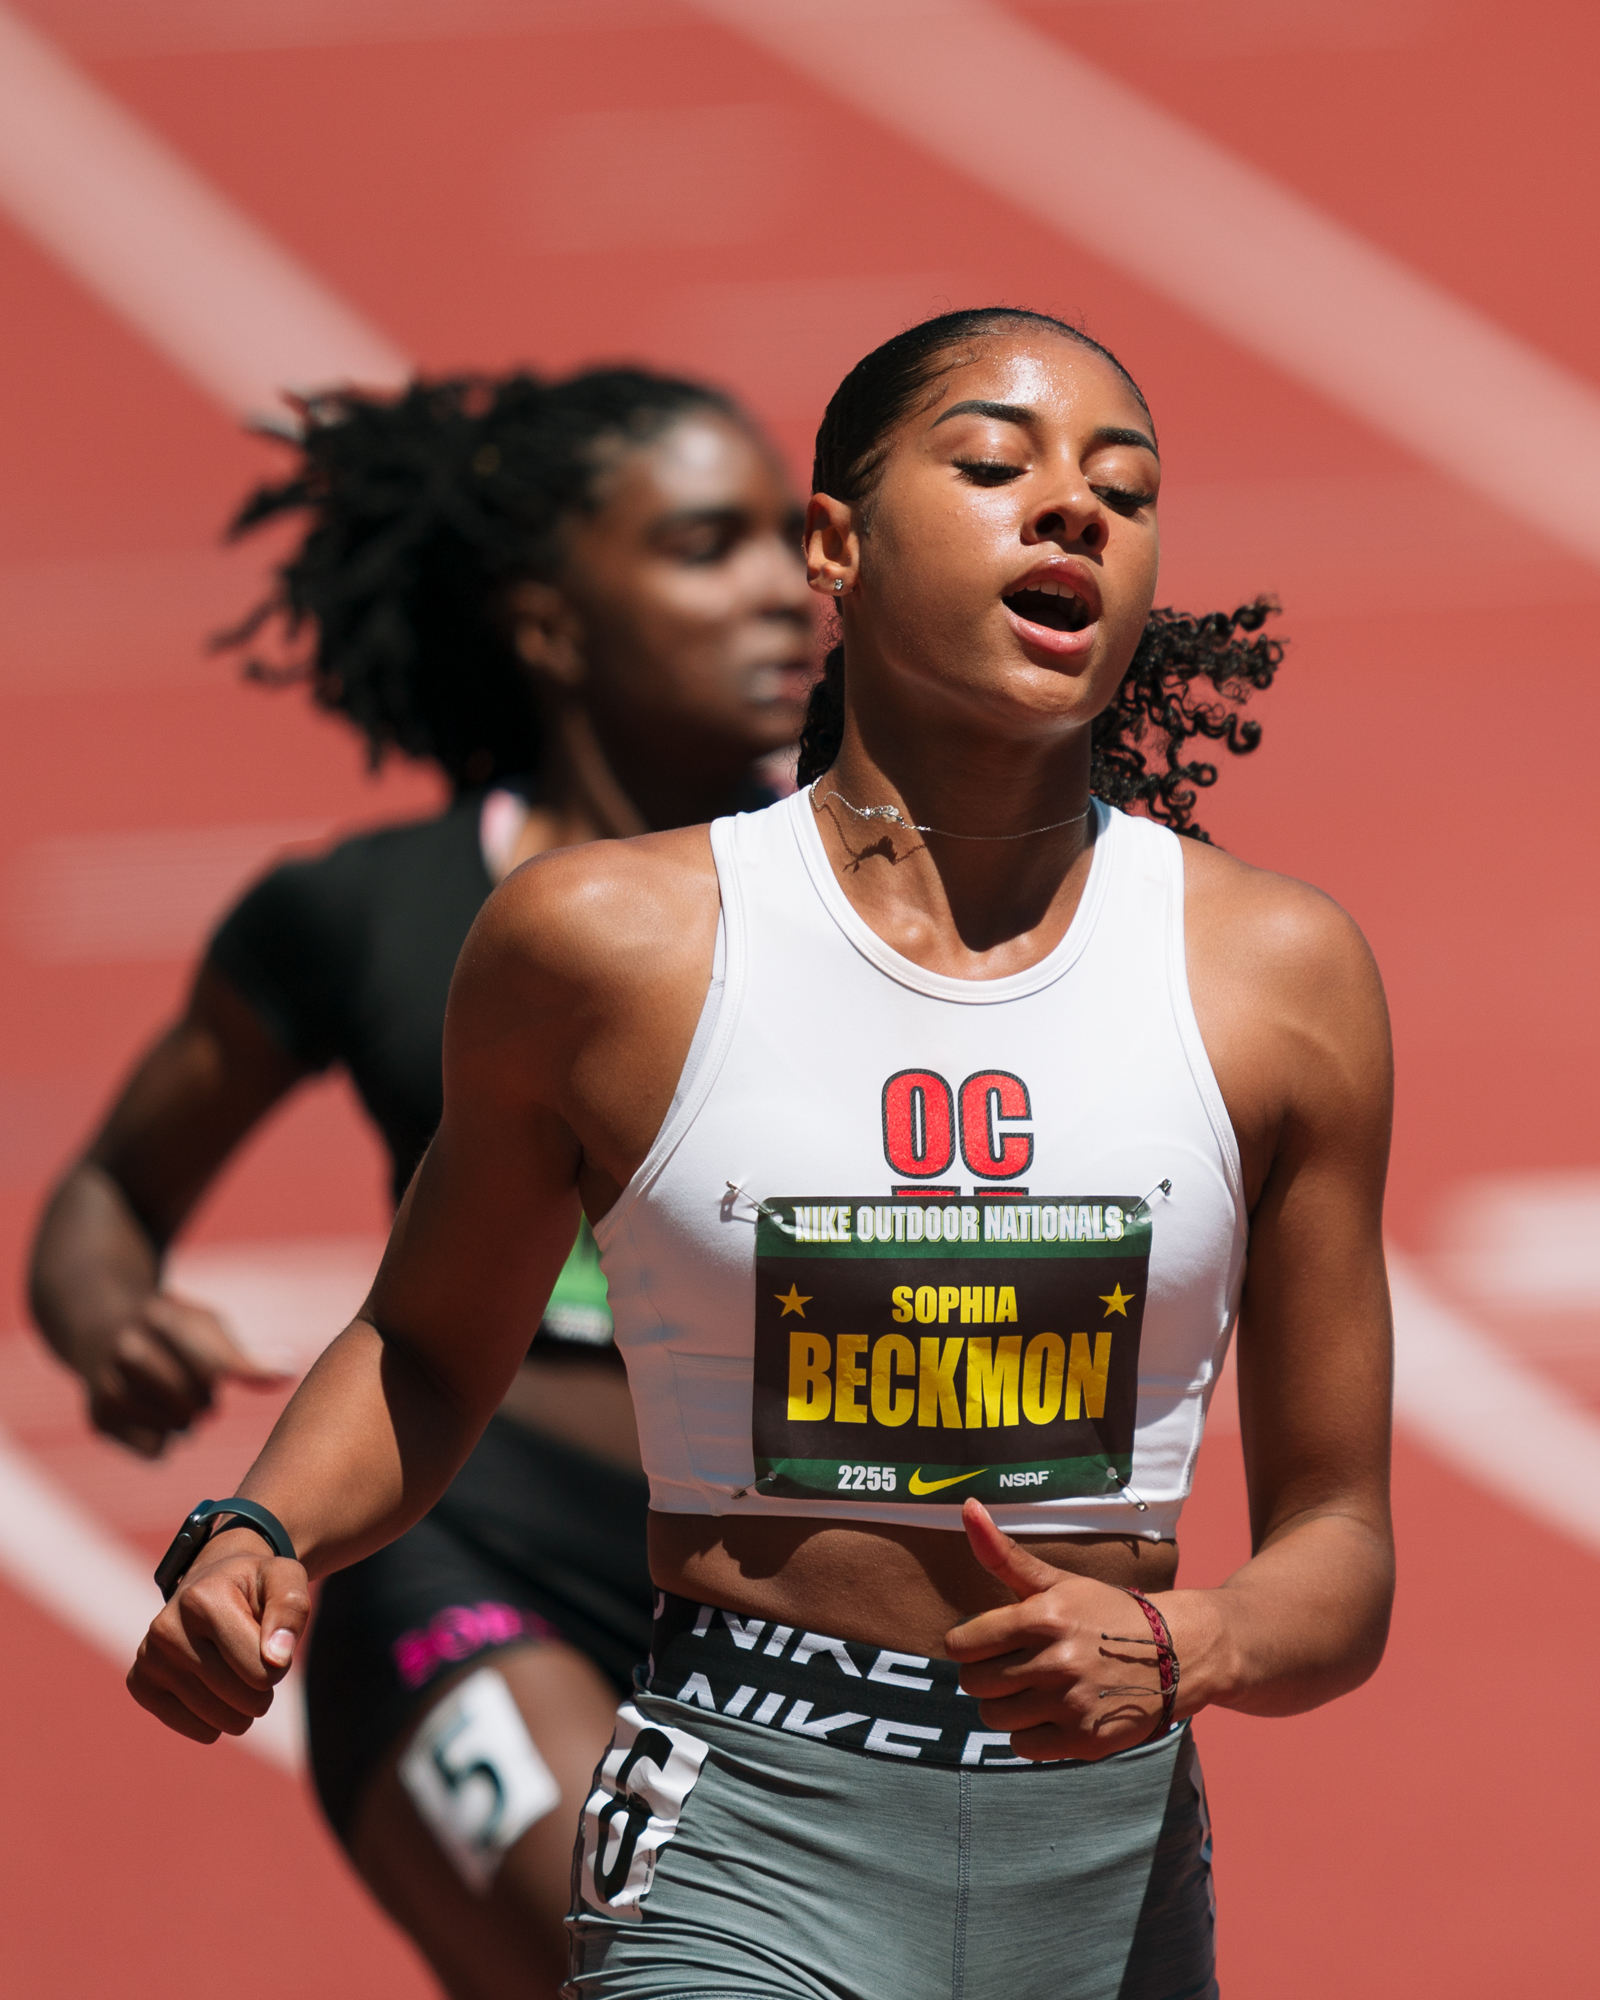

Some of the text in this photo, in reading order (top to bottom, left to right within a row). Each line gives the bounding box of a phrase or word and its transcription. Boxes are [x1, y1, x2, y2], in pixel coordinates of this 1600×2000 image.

[882, 1068, 1034, 1180] OC
[792, 1205, 1124, 1242] NIKE OUTDOOR NATIONALS
[892, 1285, 1018, 1324] SOPHIA
[787, 1331, 1112, 1429] BECKMON
[838, 1465, 1049, 1491] 2255 NSAF
[432, 1705, 506, 1852] 5
